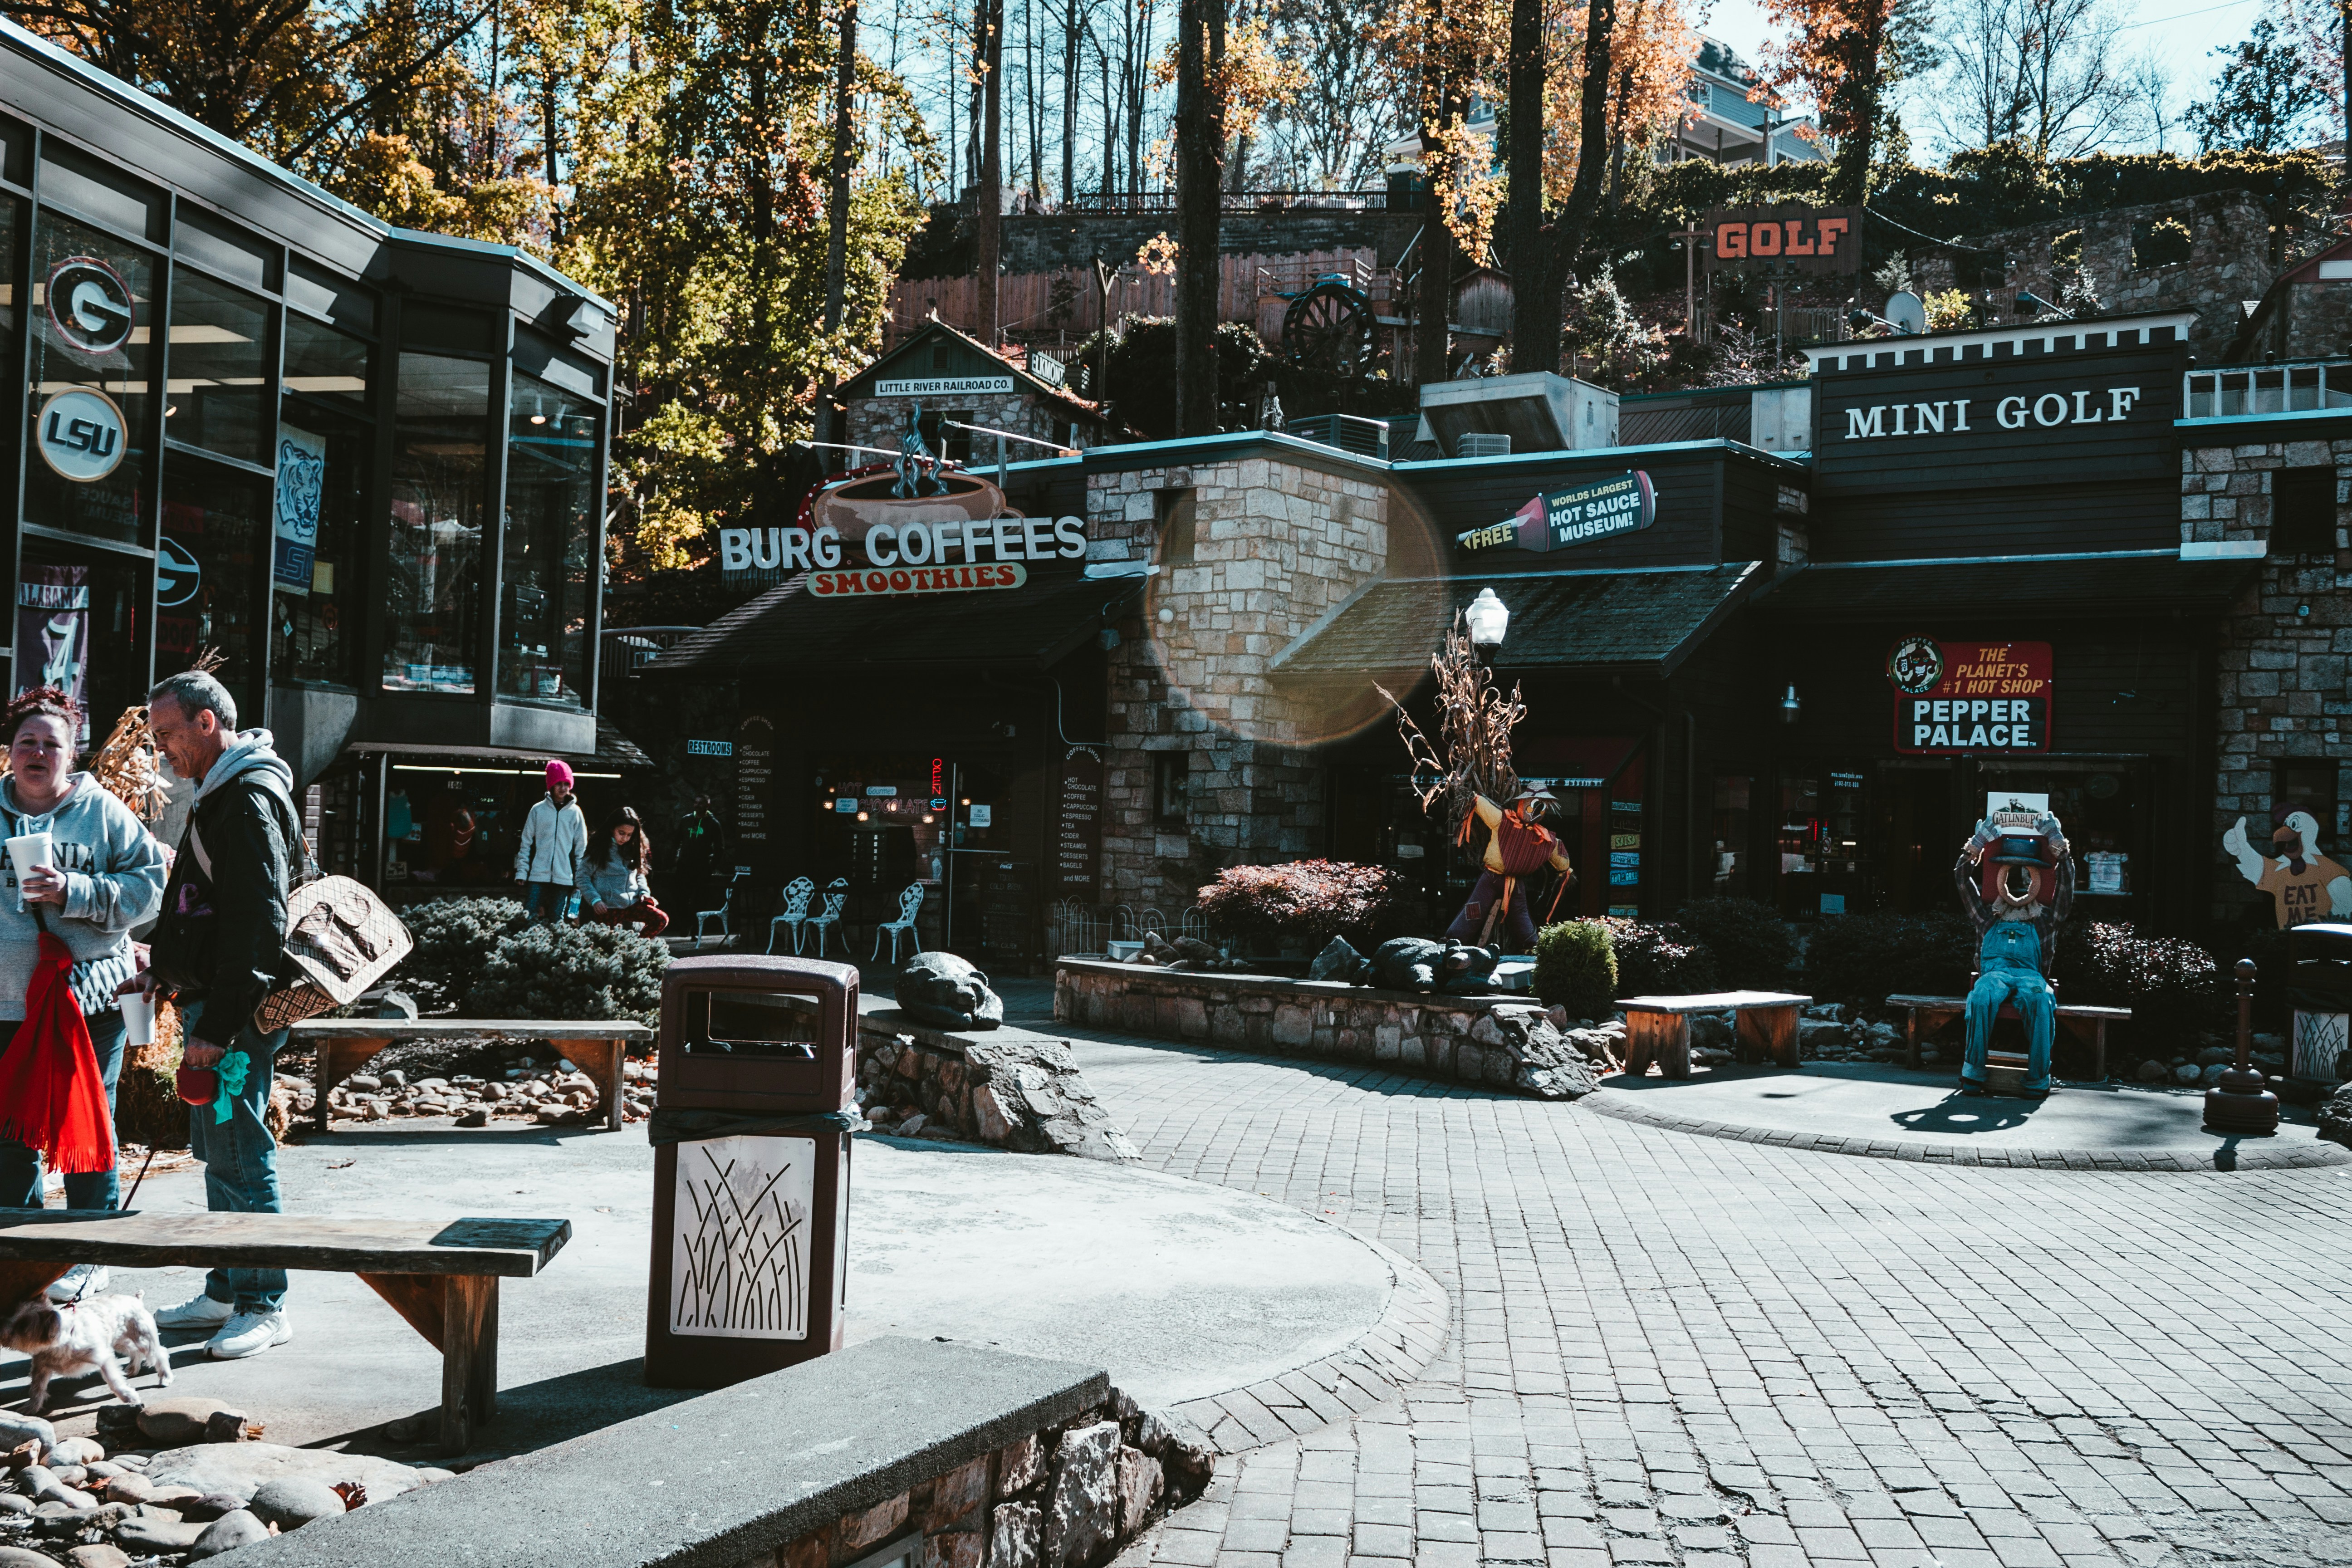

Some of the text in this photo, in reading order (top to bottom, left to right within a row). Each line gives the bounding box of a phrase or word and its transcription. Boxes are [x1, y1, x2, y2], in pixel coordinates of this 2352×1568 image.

[1716, 216, 1849, 259] GOLF
[1032, 353, 1064, 387] ELKMONT
[880, 379, 1009, 392] LITTLE RIVER RAILROAD CO.
[1845, 387, 2140, 439] MINI GOLF
[46, 411, 117, 457] LSU
[1552, 480, 1633, 507] WORLDS LARGEST
[1549, 492, 1641, 527] HOT SAUCE
[1472, 523, 1513, 549] FREE
[1559, 511, 1634, 543] MUSEUM!
[720, 515, 1087, 570] BURG COFFEES
[815, 564, 1016, 594] SMOOTHIES
[20, 584, 84, 608] ALABAMA
[1901, 637, 1933, 647] PEPPER
[1979, 648, 2008, 662] THE
[1956, 663, 2029, 678] PLANET'S
[1901, 685, 1929, 693] PALACE
[1967, 680, 1998, 693] HOT
[2000, 679, 2043, 693] SHOP
[1914, 700, 2030, 722] PEPPER
[740, 715, 774, 730] COFFEE SHOP
[1914, 725, 2029, 746] PALACE
[688, 741, 731, 755] RESTROOMS
[1066, 745, 1101, 763] COFFEE SHOP
[932, 758, 942, 795] OPEN
[838, 782, 862, 797] HOT
[858, 798, 928, 814] CHOCOLATE
[1066, 803, 1098, 811] CAPPUCCINO
[1992, 812, 2043, 824] GATLINBURG
[2284, 883, 2318, 905] EAT
[2286, 906, 2316, 924] ME
